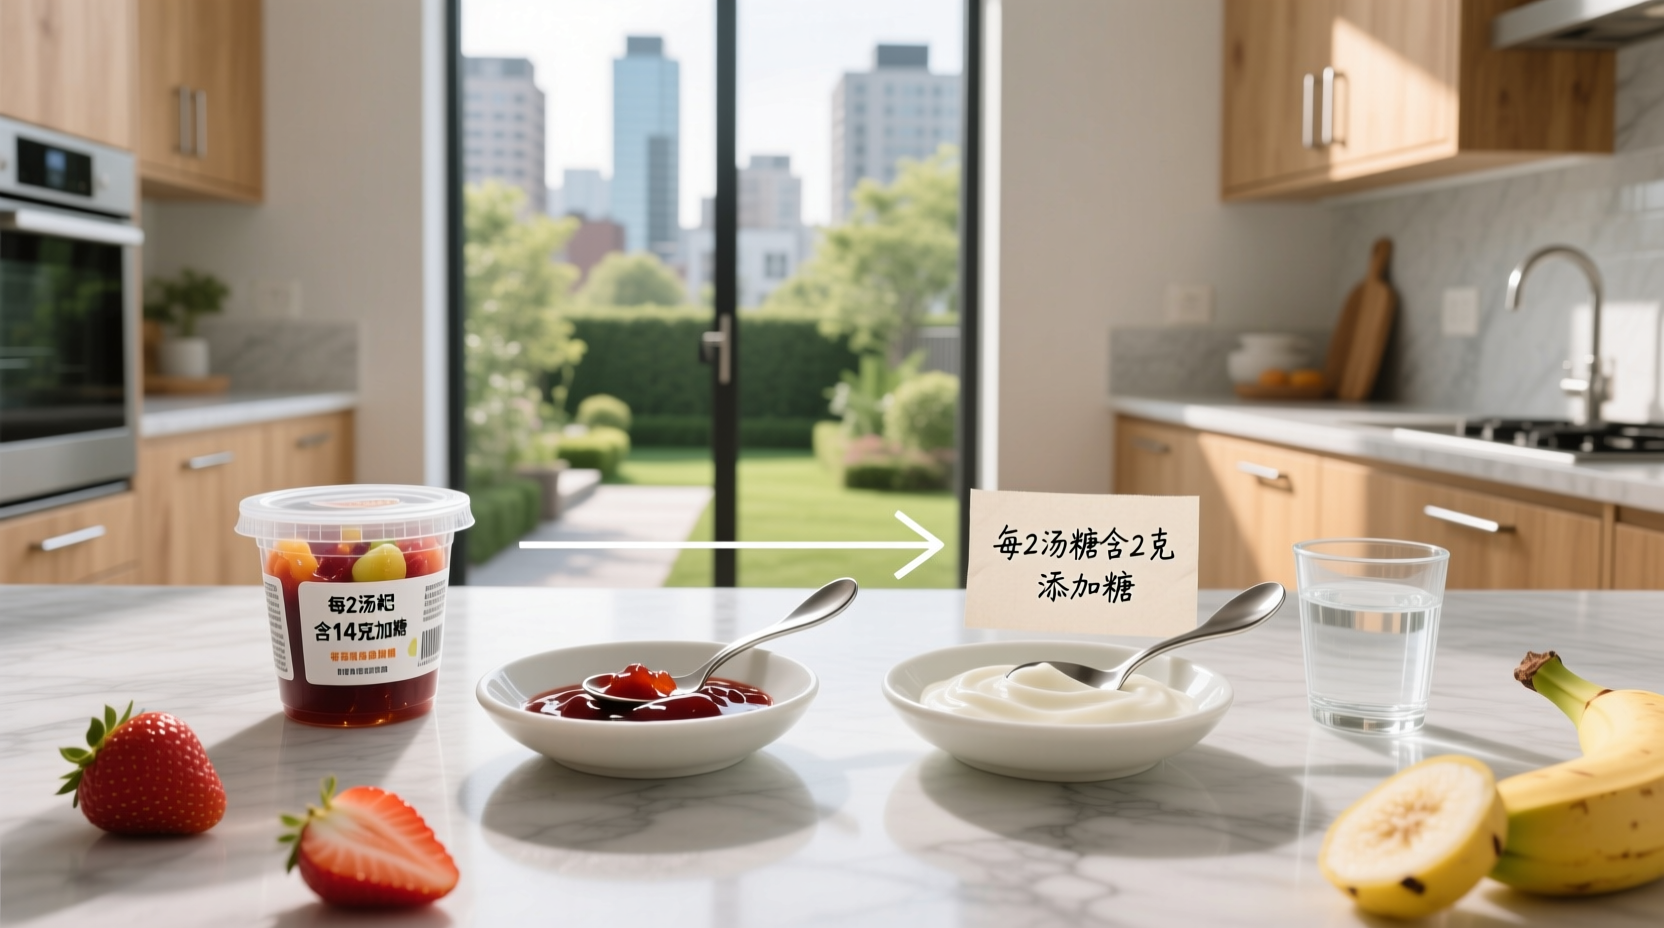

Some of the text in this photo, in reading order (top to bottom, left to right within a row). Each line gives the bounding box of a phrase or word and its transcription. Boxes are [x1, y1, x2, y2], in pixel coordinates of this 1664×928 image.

[993, 524, 1175, 561] 每2汤糖含2克
[1038, 570, 1135, 603] 添加糖
